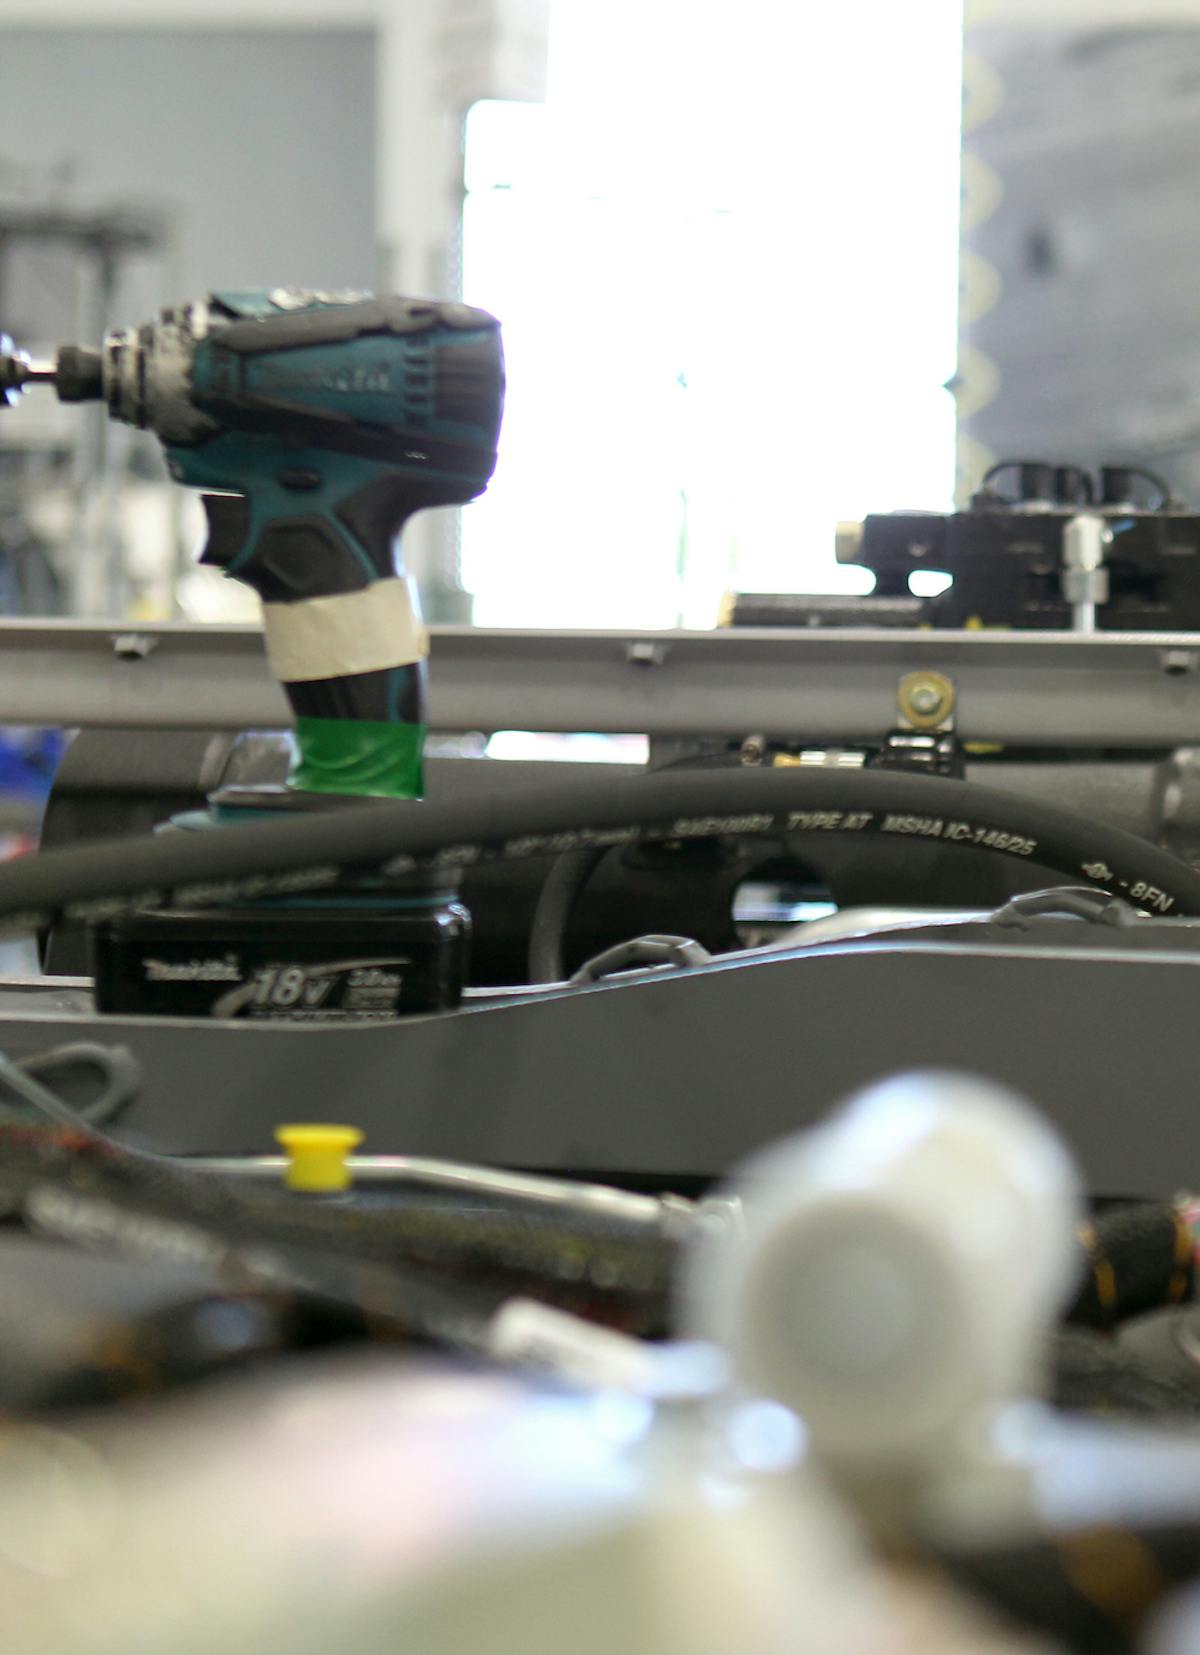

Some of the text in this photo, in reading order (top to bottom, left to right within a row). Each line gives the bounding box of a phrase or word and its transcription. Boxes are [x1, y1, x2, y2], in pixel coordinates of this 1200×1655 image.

[786, 811, 843, 830] TYPE
[840, 812, 873, 830] AT
[882, 814, 943, 836] MSHA
[1130, 882, 1174, 912] 8FN
